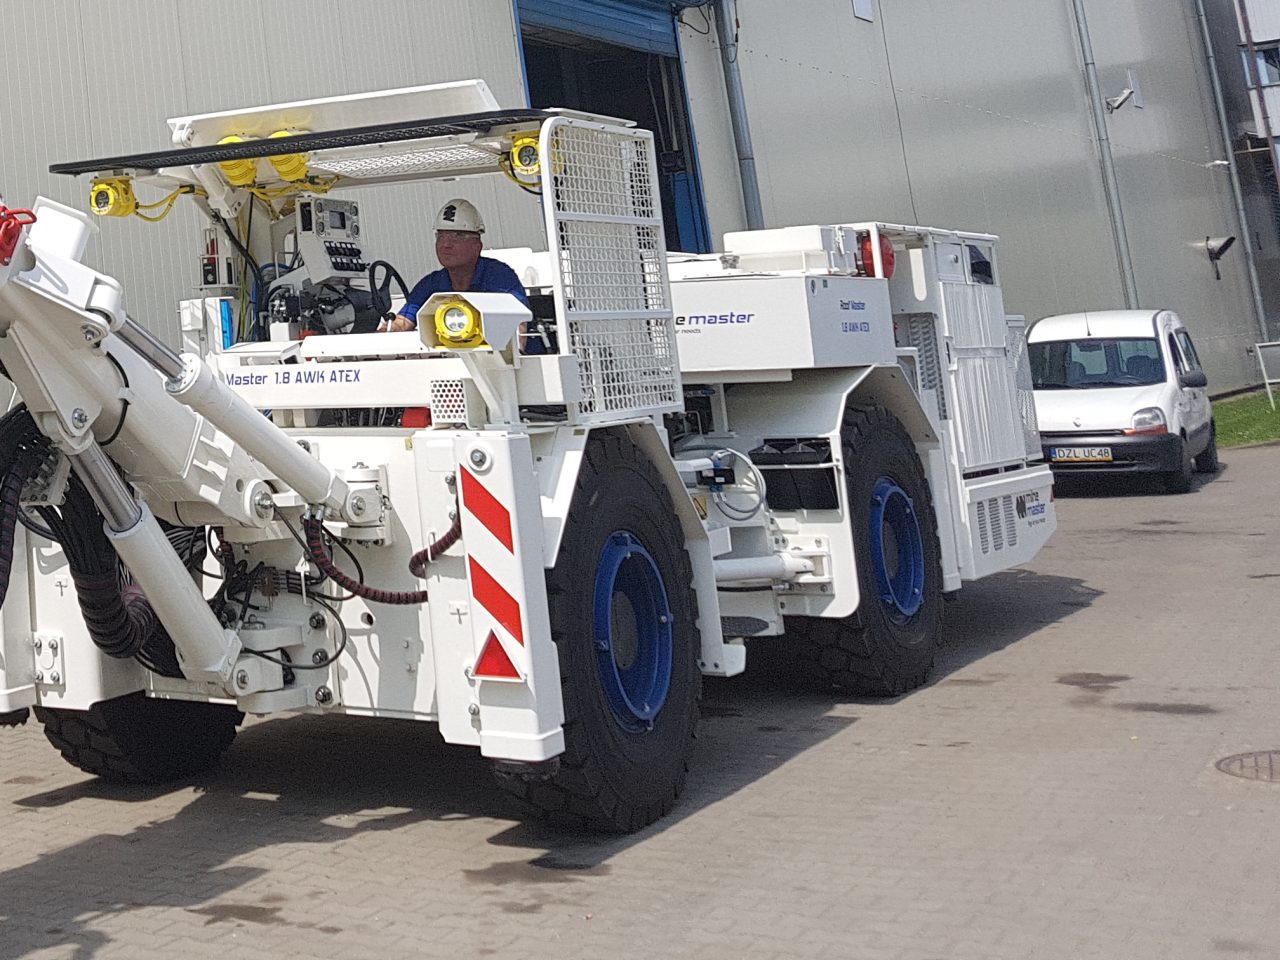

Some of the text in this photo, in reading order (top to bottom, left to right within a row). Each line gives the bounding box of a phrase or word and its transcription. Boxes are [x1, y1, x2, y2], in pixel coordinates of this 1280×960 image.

[688, 312, 755, 325] master
[226, 373, 268, 386] Master
[275, 371, 290, 384] 1.8
[329, 369, 361, 383] ATEX
[1057, 448, 1080, 458] DZL
